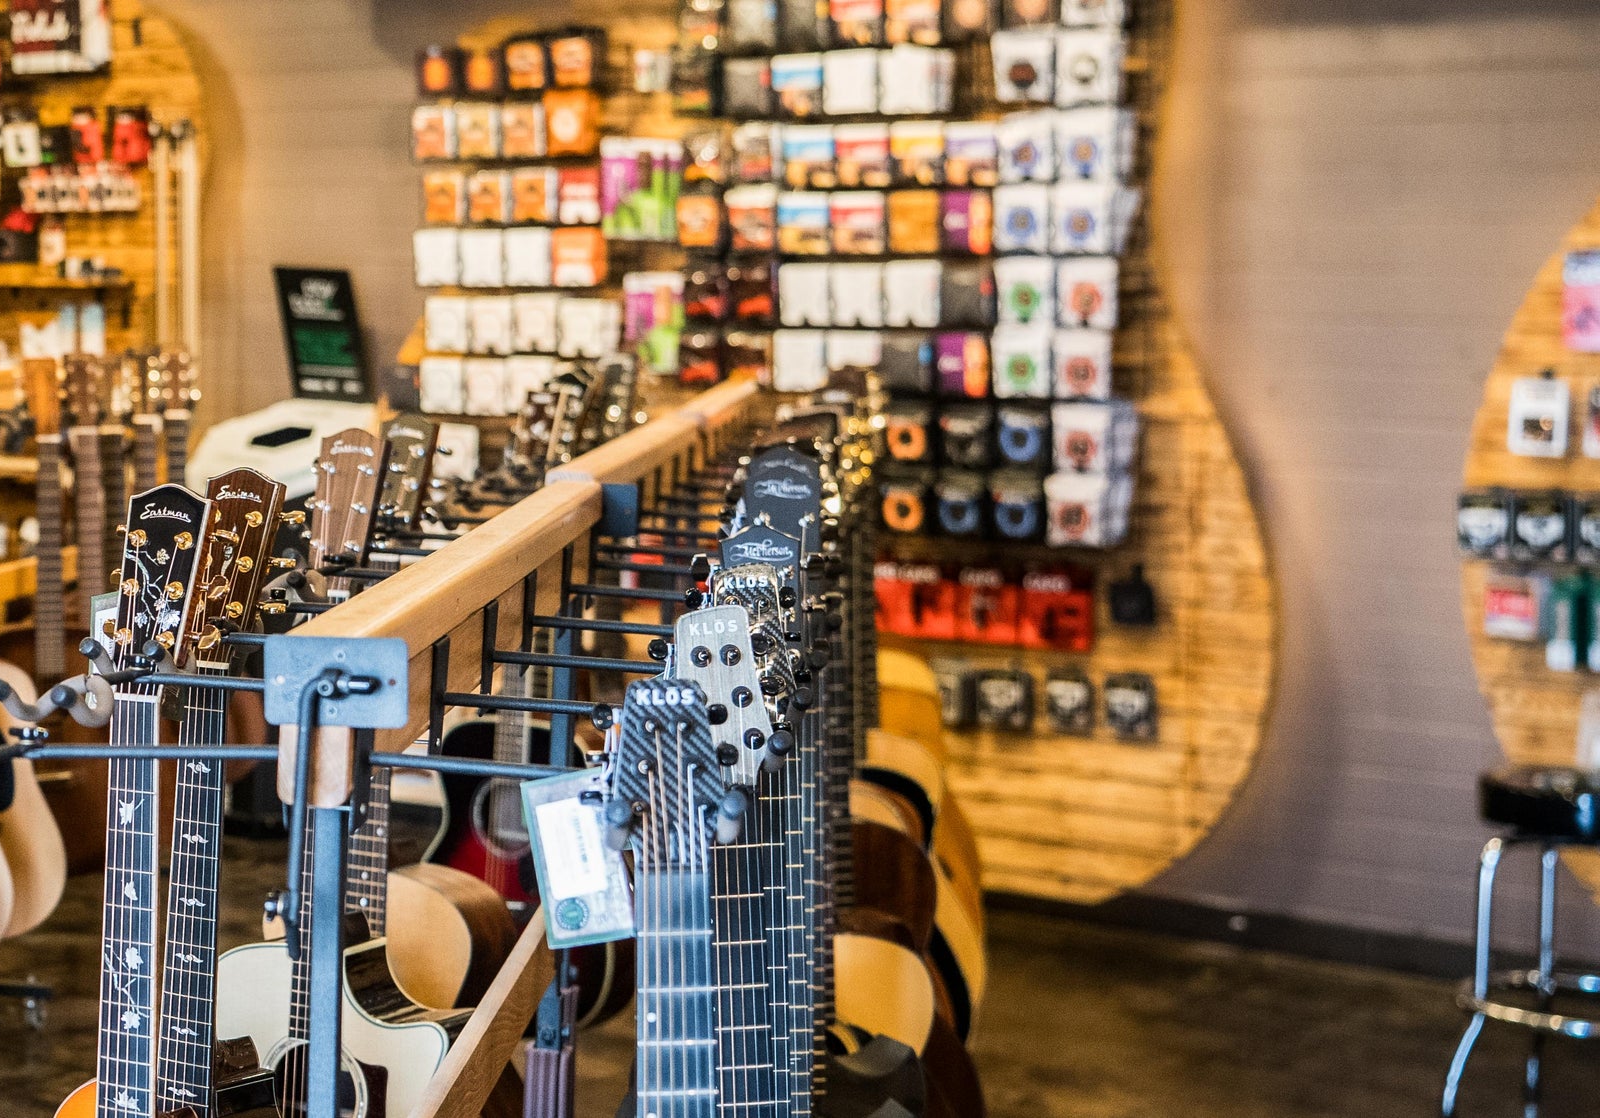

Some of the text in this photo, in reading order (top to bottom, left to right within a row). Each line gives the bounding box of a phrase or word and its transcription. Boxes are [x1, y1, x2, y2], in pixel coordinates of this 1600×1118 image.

[215, 485, 262, 503] Eastman
[140, 502, 192, 523] Eastman
[730, 539, 794, 562] McPherson
